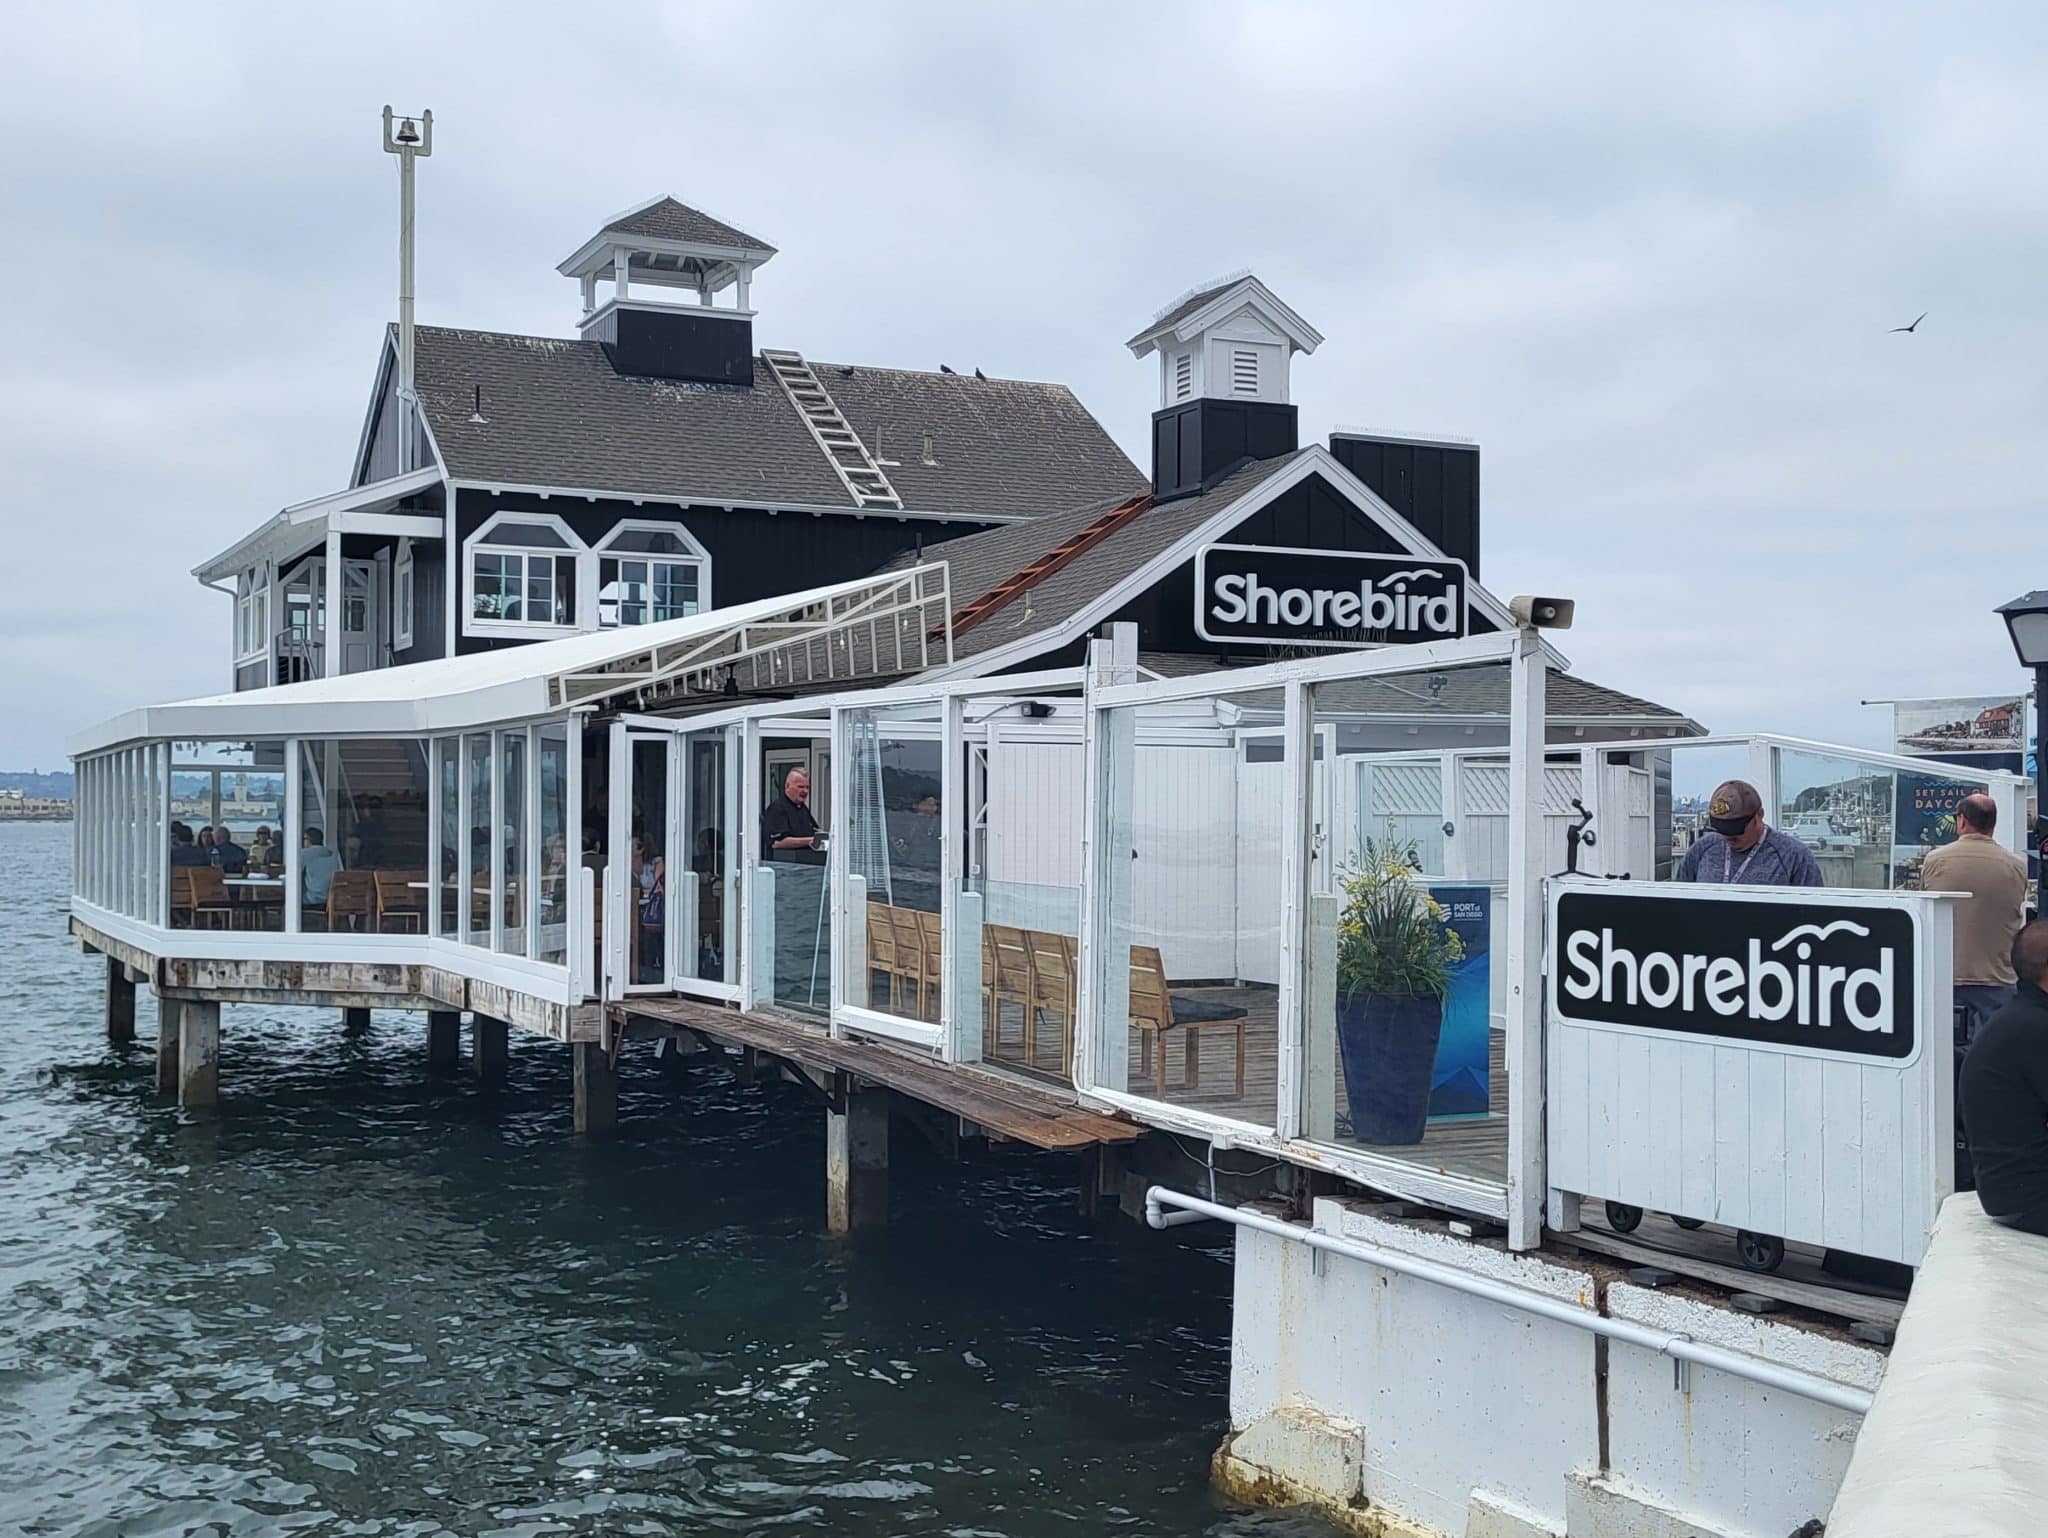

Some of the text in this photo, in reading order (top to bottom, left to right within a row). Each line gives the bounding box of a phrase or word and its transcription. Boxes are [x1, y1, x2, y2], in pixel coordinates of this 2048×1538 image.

[1212, 572, 1457, 633] Shorebird
[1915, 788, 1935, 797] SET
[1940, 788, 1966, 797] SAIL
[1454, 903, 1475, 911] PORT
[1564, 927, 1895, 1034] Shorebird
